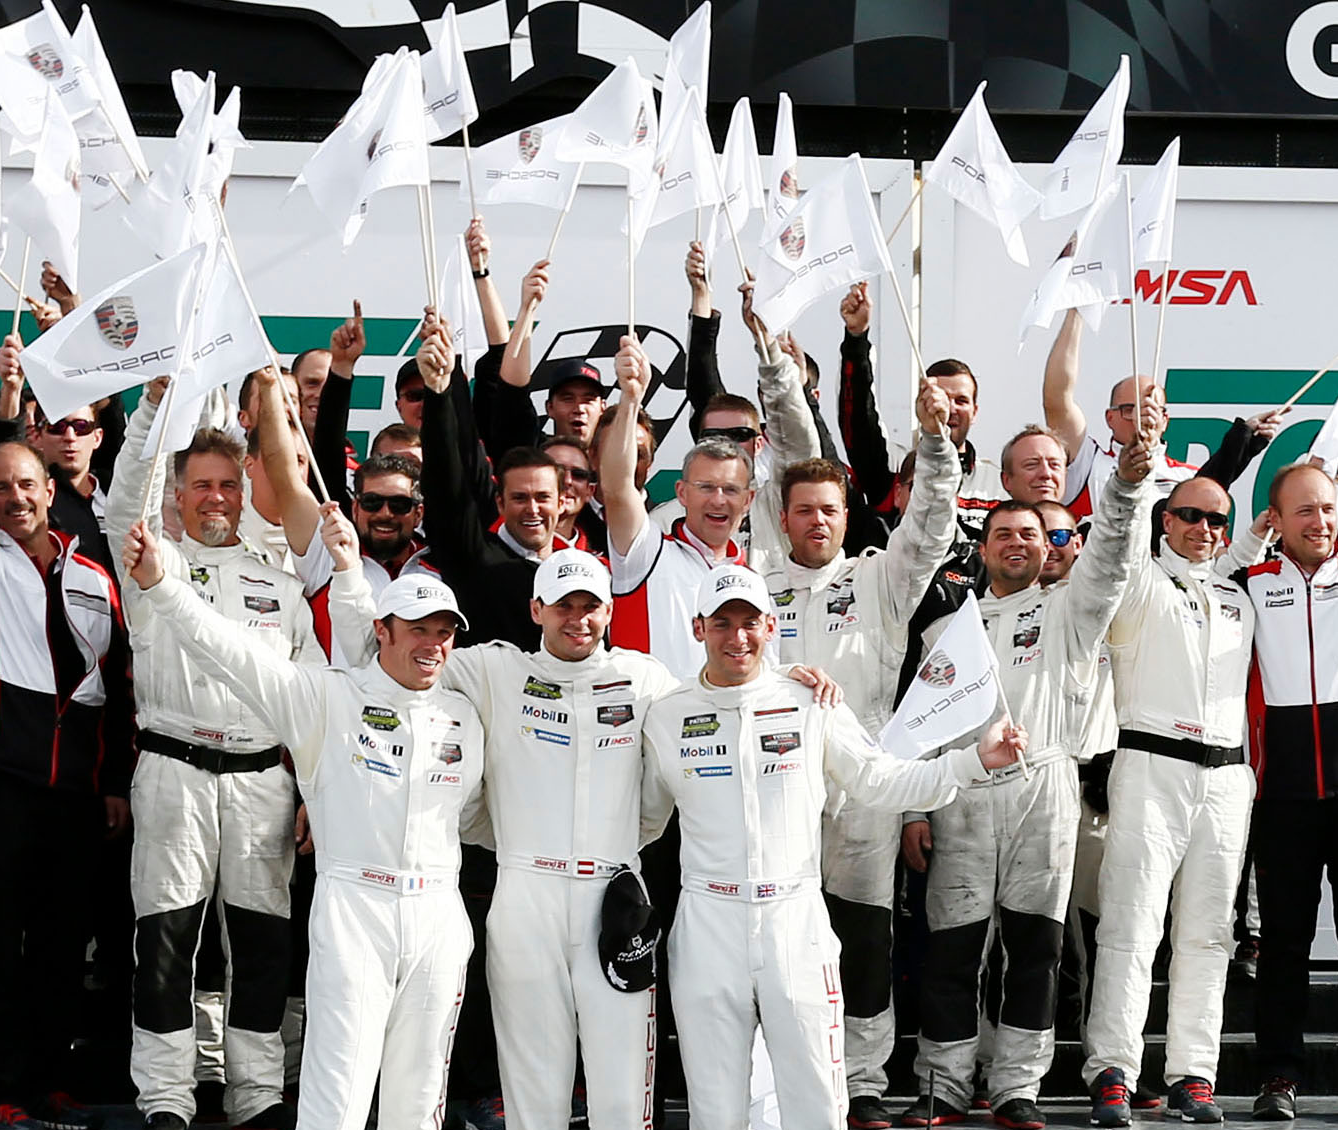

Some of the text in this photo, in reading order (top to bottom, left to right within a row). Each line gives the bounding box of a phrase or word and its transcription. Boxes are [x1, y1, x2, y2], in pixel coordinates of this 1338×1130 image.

[1111, 269, 1259, 306] MSA
[522, 704, 568, 725] Mobil 1
[681, 744, 727, 759] Mobil 1
